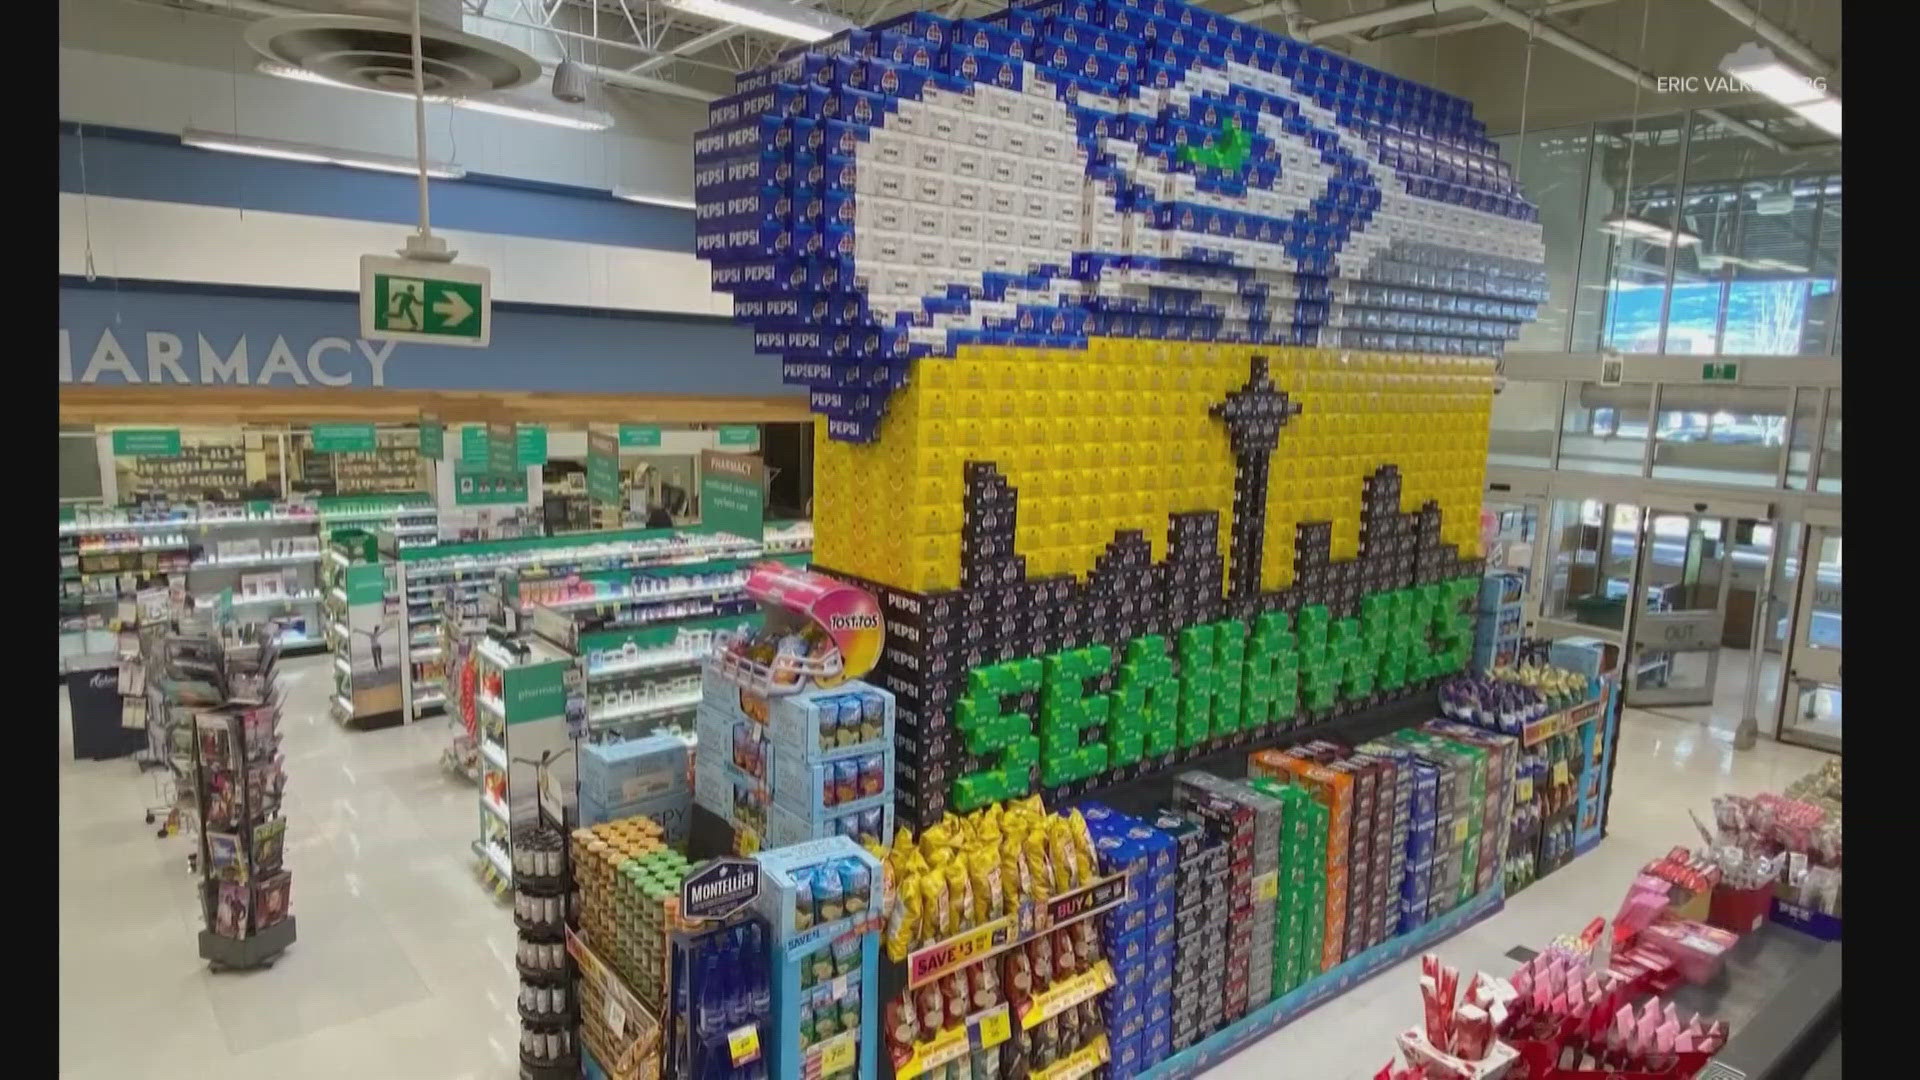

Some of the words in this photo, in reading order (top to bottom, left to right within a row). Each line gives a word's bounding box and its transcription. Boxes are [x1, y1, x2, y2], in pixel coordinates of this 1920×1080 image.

[737, 75, 766, 94] PEPSI
[771, 63, 802, 84] PEPSI
[711, 104, 740, 123] PEPSI
[743, 94, 775, 115] PEPSI
[695, 134, 724, 155] PEPSI
[728, 127, 759, 147] PEPSI
[696, 168, 725, 187] PEPSI
[728, 161, 759, 181] PEPSI
[697, 202, 725, 220] PEPSI
[728, 196, 759, 215] PEPSI
[697, 234, 725, 250] PEPSI
[729, 229, 760, 247] PEPSI
[712, 268, 740, 284] PEPSI
[744, 265, 775, 281] PEPSI
[734, 302, 763, 317] PEPSI
[767, 300, 798, 315] PEPSI
[756, 333, 785, 347] PEPSI
[789, 333, 820, 348] PEPSI
[811, 392, 841, 407] PEPSI
[830, 420, 859, 436] PEPSI
[710, 457, 752, 476] PHARMACY
[888, 592, 920, 615] PEPSI
[887, 620, 919, 643] PEPSI
[1664, 623, 1694, 643] OUT
[887, 648, 919, 672] PEPSI
[887, 675, 918, 699] PEPSI
[953, 577, 1479, 813] SEAHAWKS
[1057, 895, 1084, 918] BUY
[917, 946, 957, 976] SAVE
